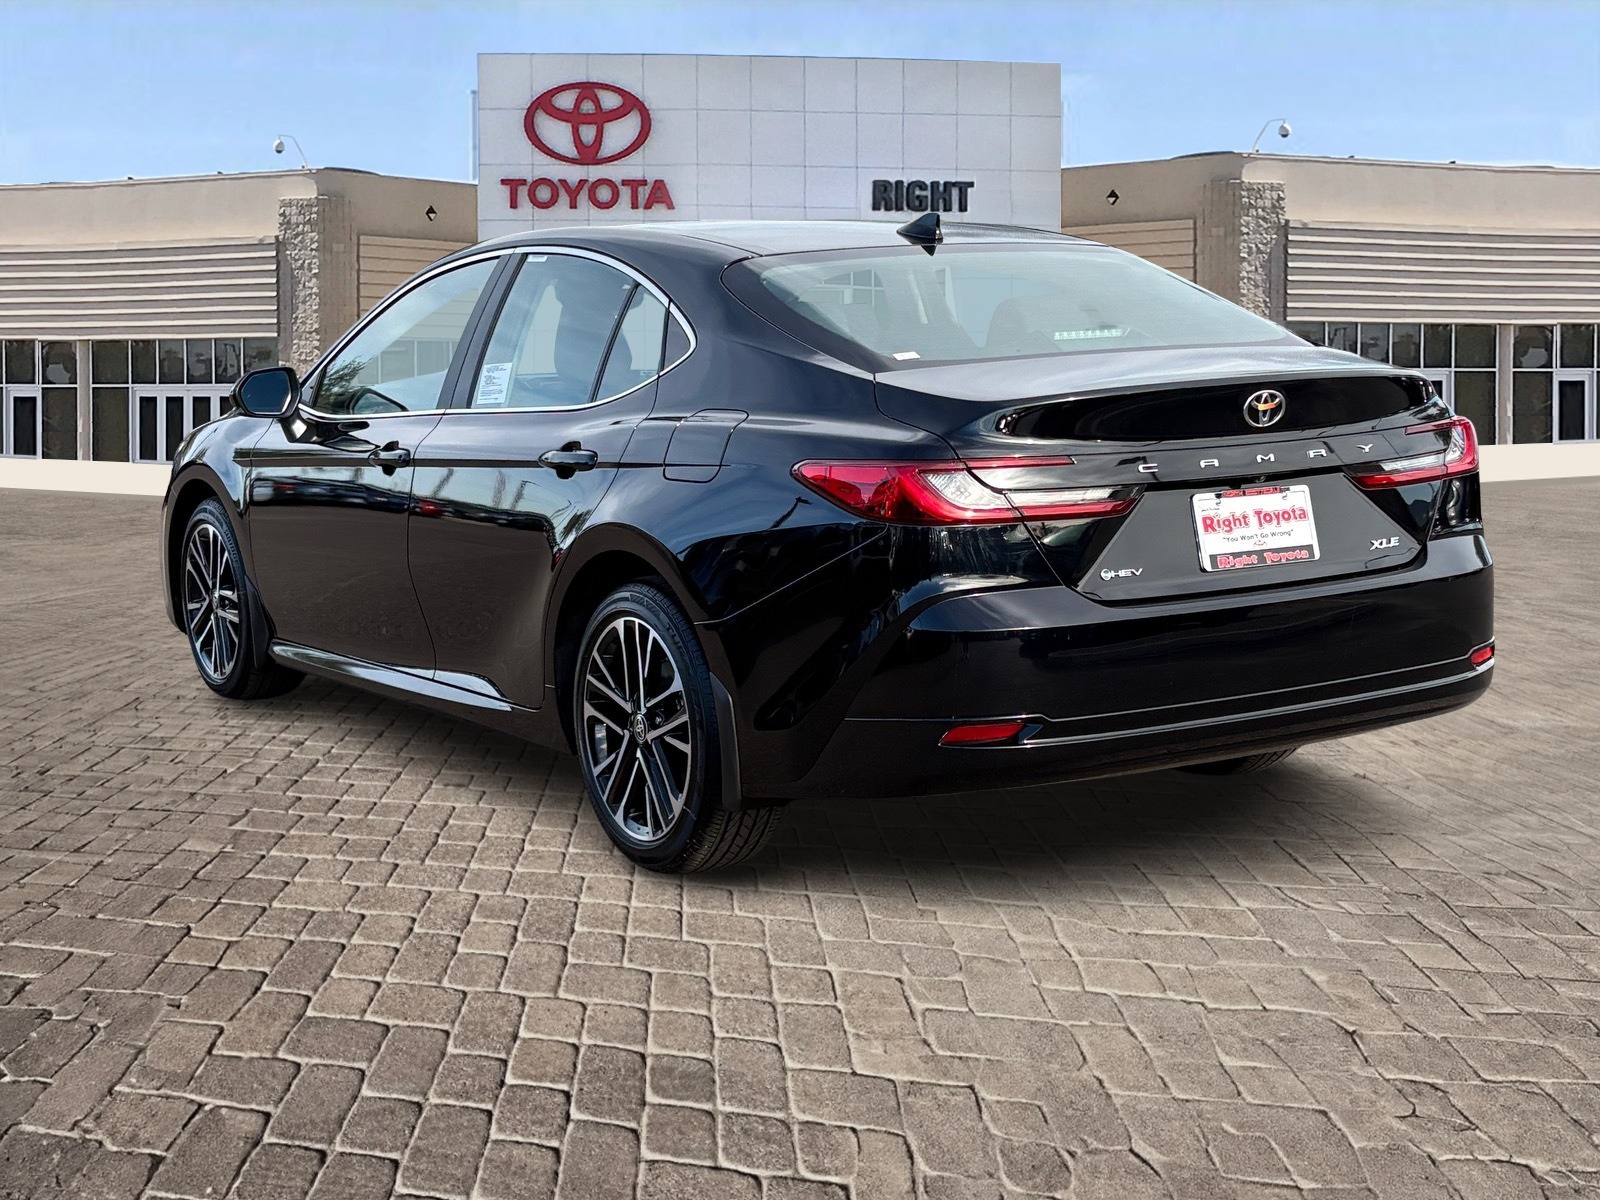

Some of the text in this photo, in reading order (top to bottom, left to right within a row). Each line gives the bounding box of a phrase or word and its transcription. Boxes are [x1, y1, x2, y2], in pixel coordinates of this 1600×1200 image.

[501, 178, 675, 210] TOYOTA
[872, 179, 975, 213] RIGHT
[1138, 443, 1374, 473] CAMRY
[1202, 507, 1307, 534] Right Toyota
[1370, 536, 1400, 550] XLE
[1217, 549, 1309, 568] Right Toyota
[1110, 568, 1143, 578] HEV
